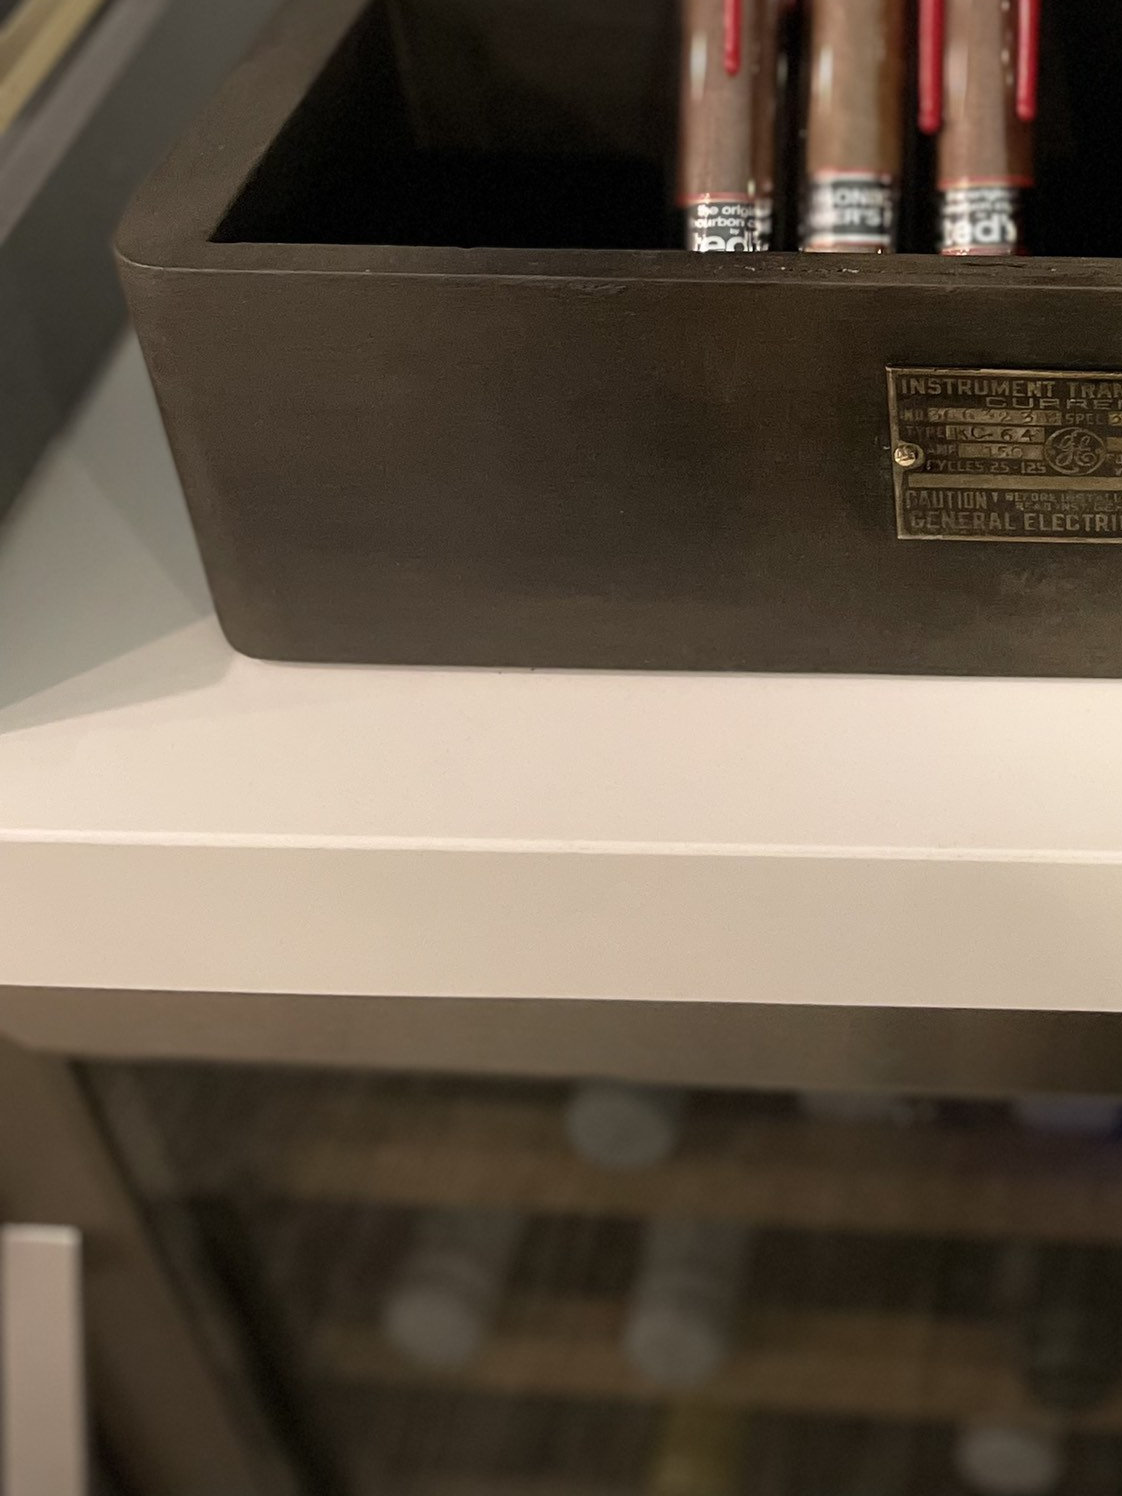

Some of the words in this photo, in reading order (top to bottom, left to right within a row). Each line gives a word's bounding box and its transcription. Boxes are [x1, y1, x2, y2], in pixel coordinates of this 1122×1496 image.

[697, 203, 719, 217] the
[901, 378, 1056, 399] INSTRUMENT
[911, 511, 1017, 532] GENERAL
